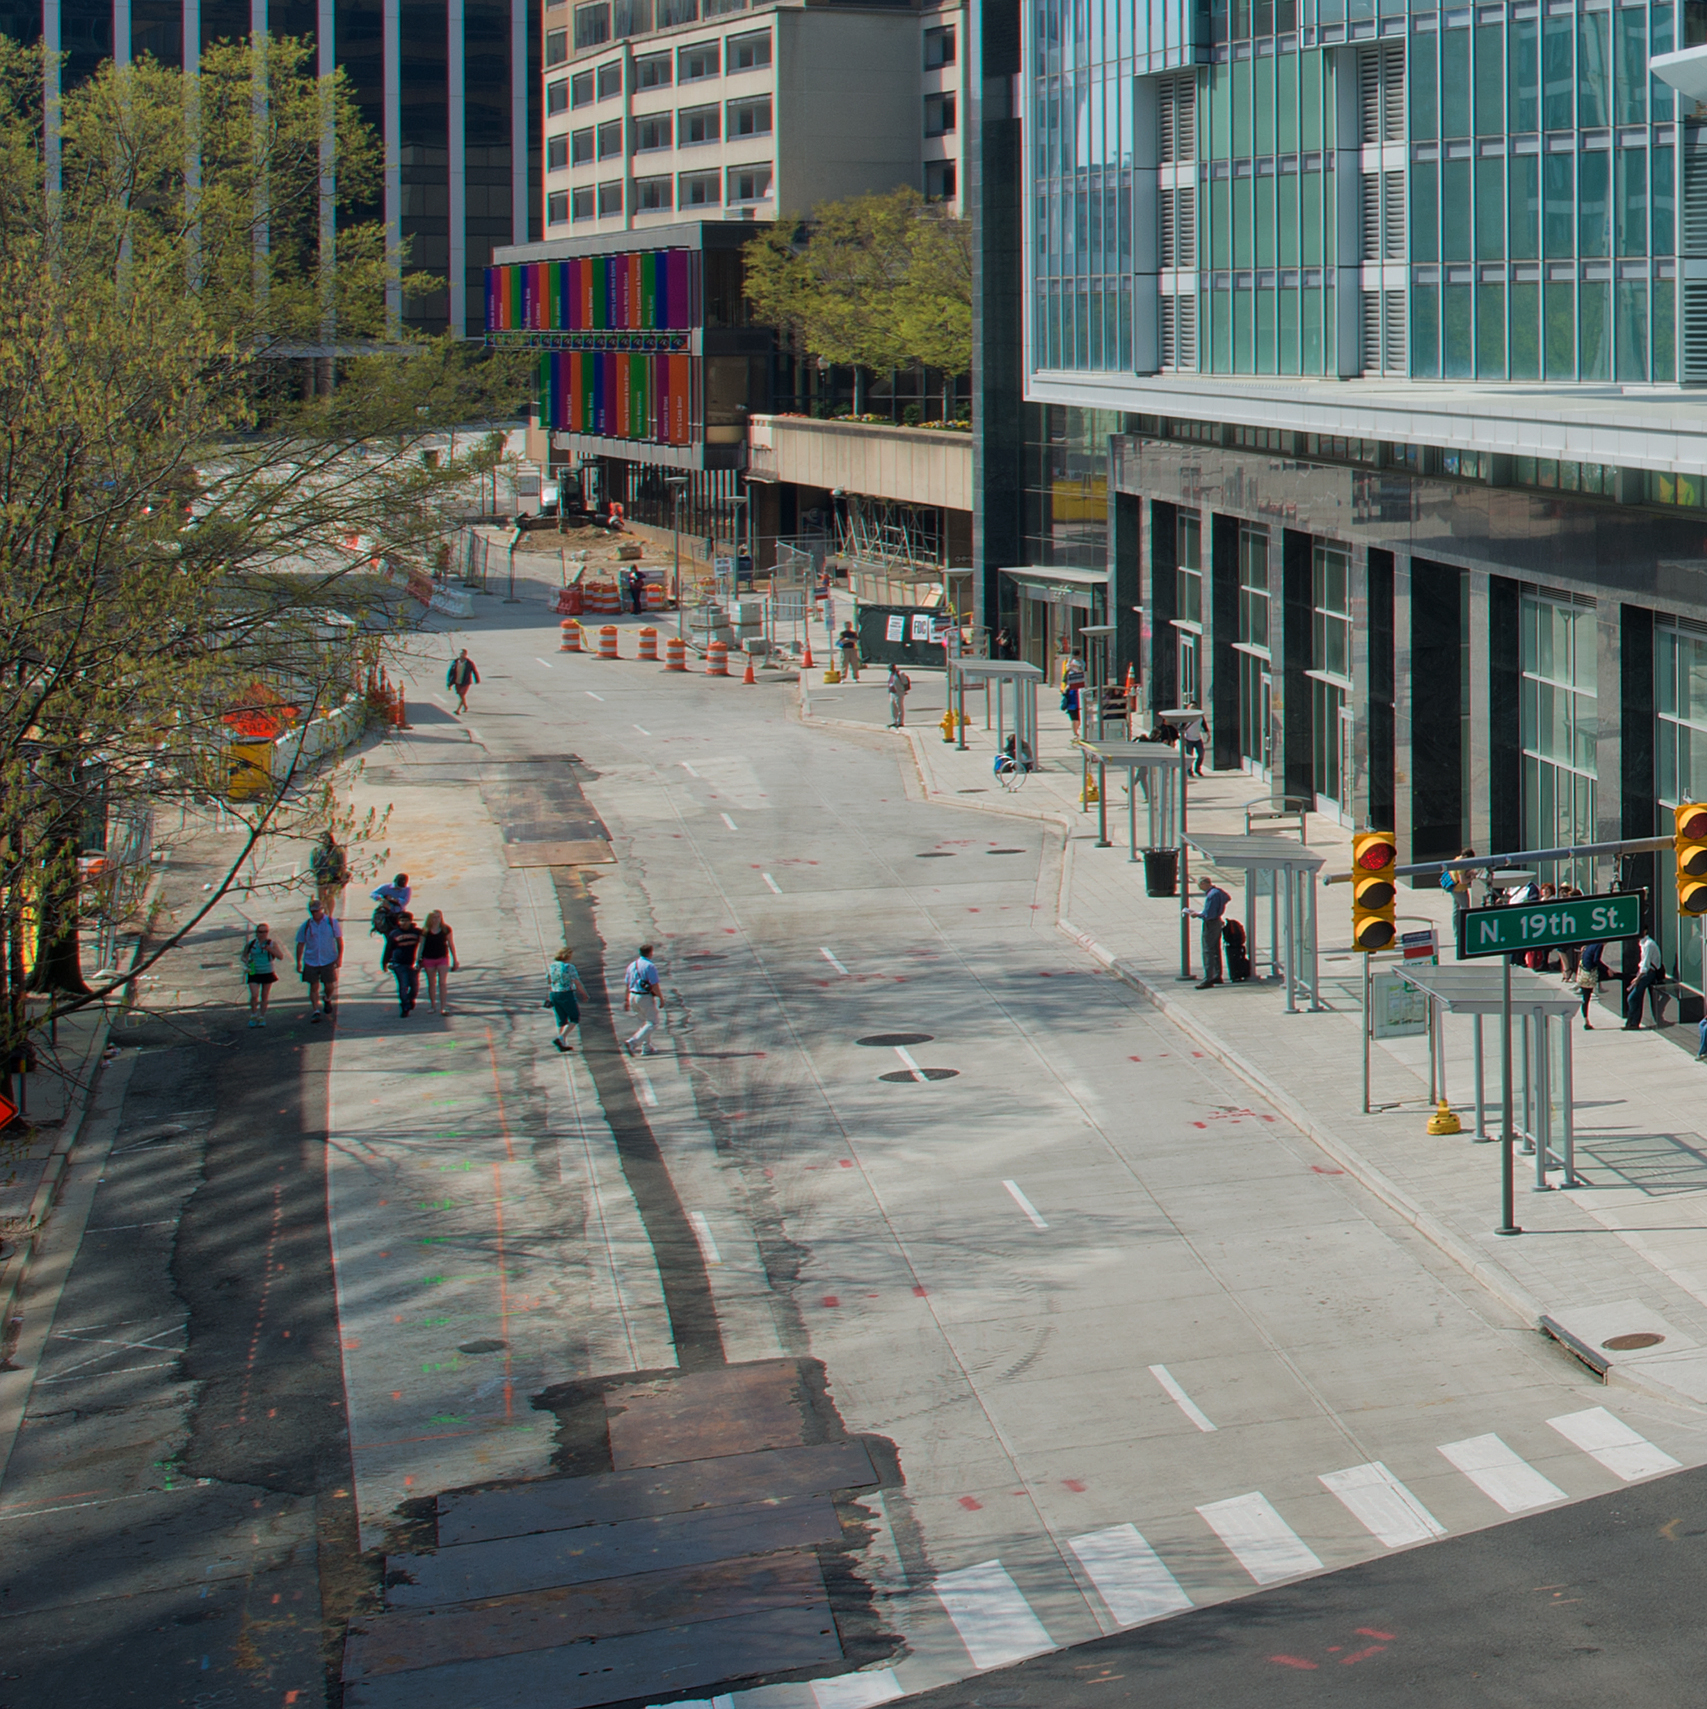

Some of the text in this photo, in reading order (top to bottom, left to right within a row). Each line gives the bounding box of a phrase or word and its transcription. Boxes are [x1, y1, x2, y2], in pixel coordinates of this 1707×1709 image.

[1480, 906, 1625, 944] N. 19th St.
